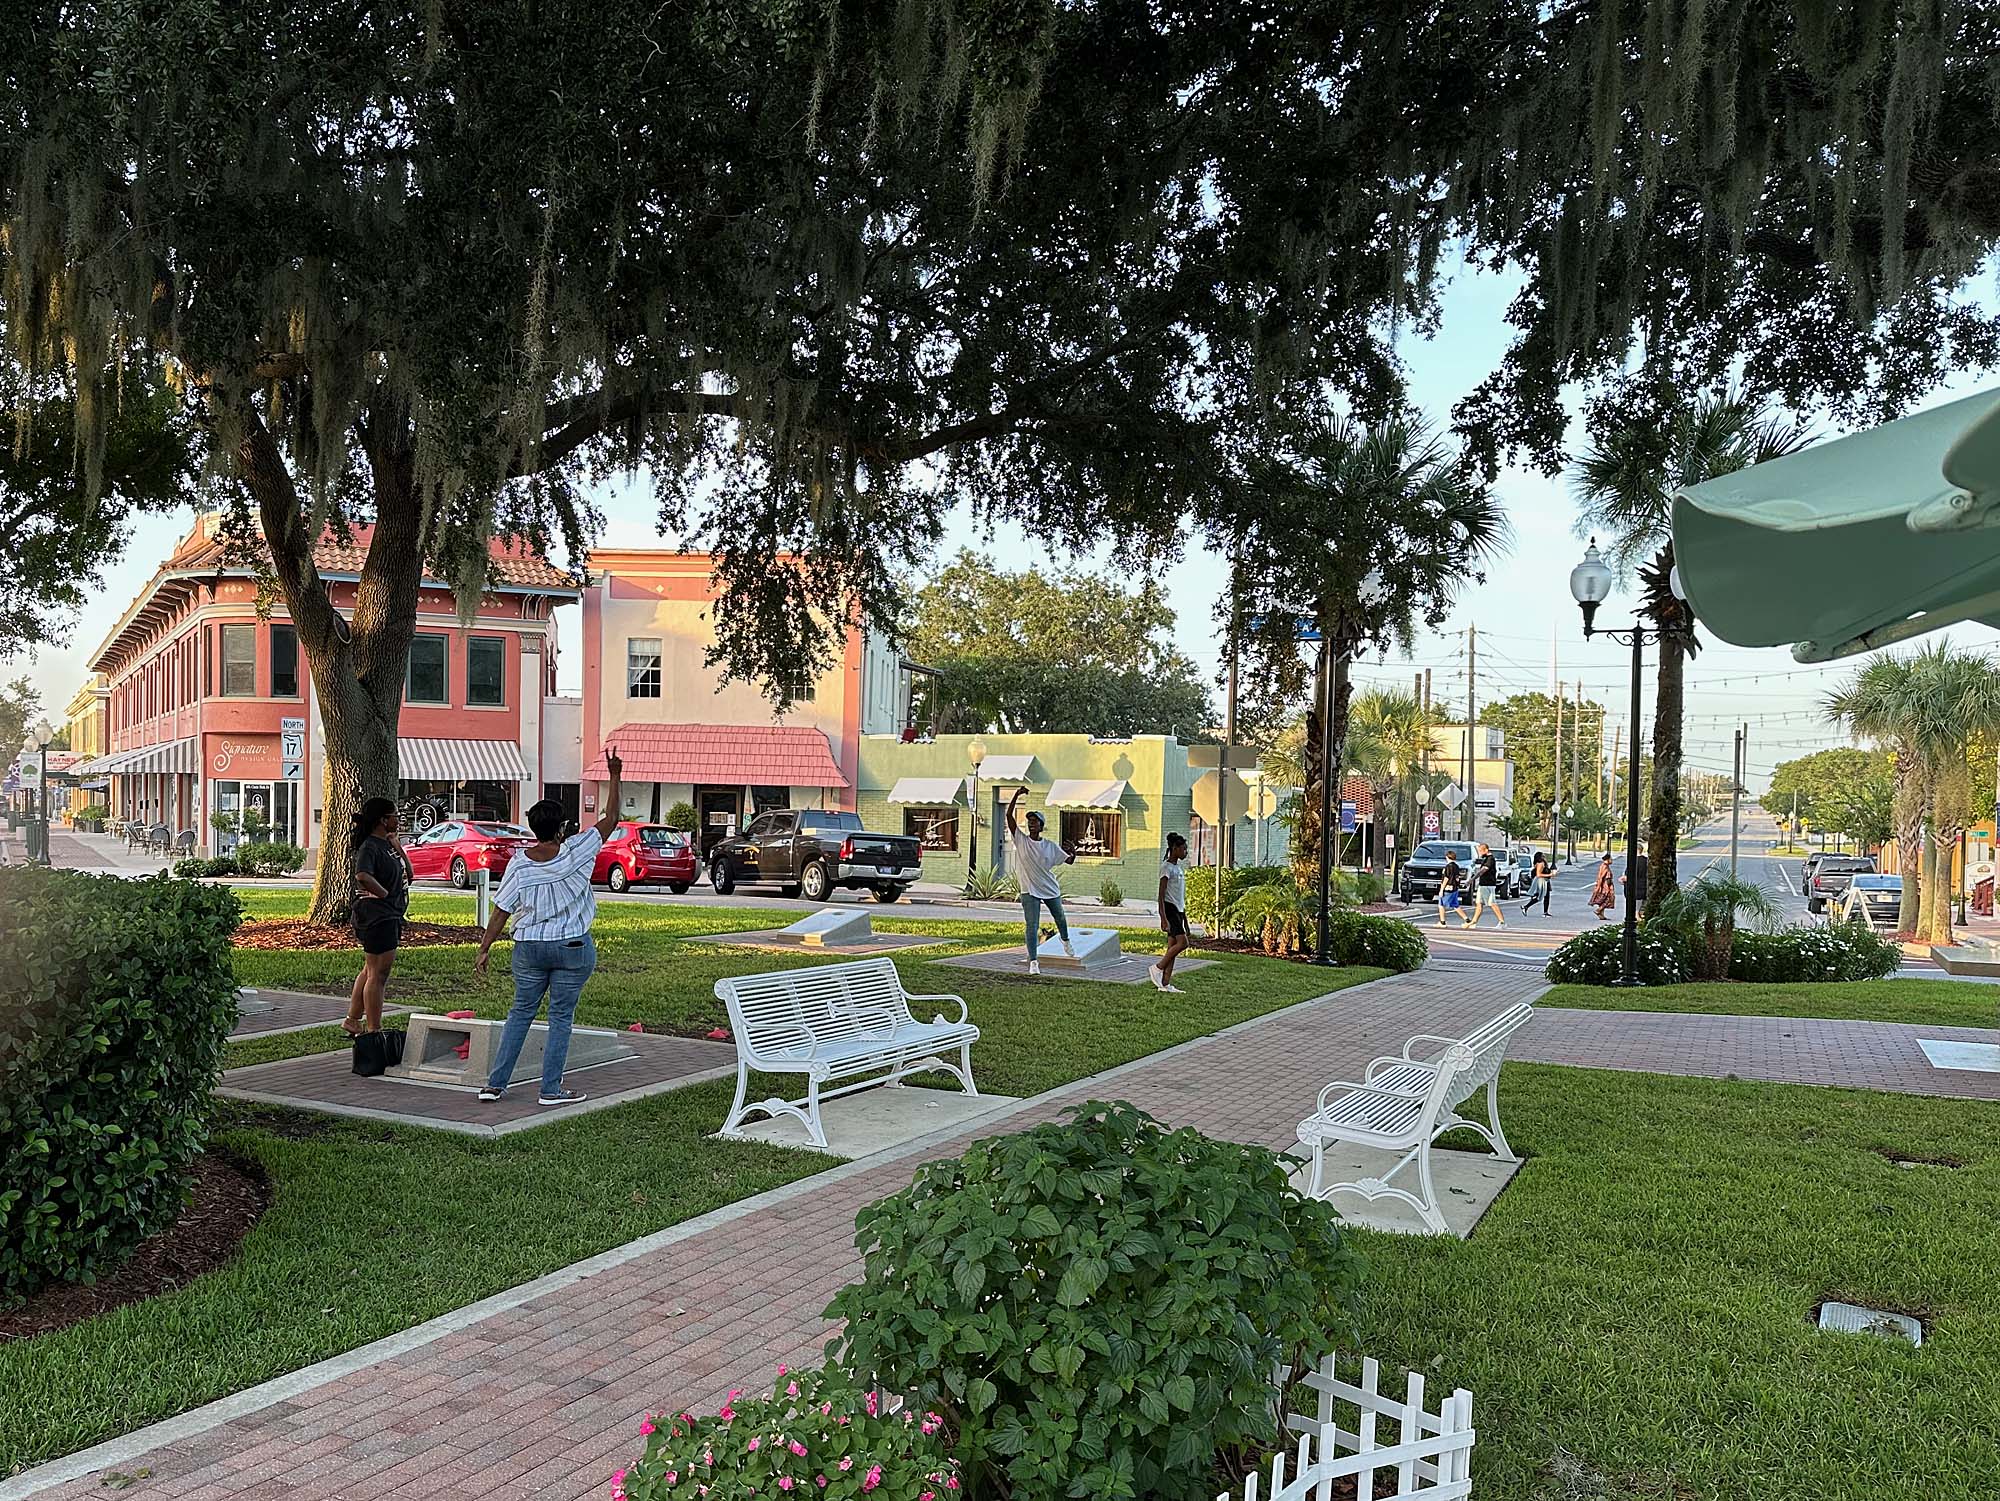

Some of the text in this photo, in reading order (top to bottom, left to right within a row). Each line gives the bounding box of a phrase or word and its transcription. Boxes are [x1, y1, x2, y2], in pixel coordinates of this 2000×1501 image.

[283, 719, 304, 729] NORTH
[214, 740, 270, 772] Signature
[287, 743, 297, 756] 17
